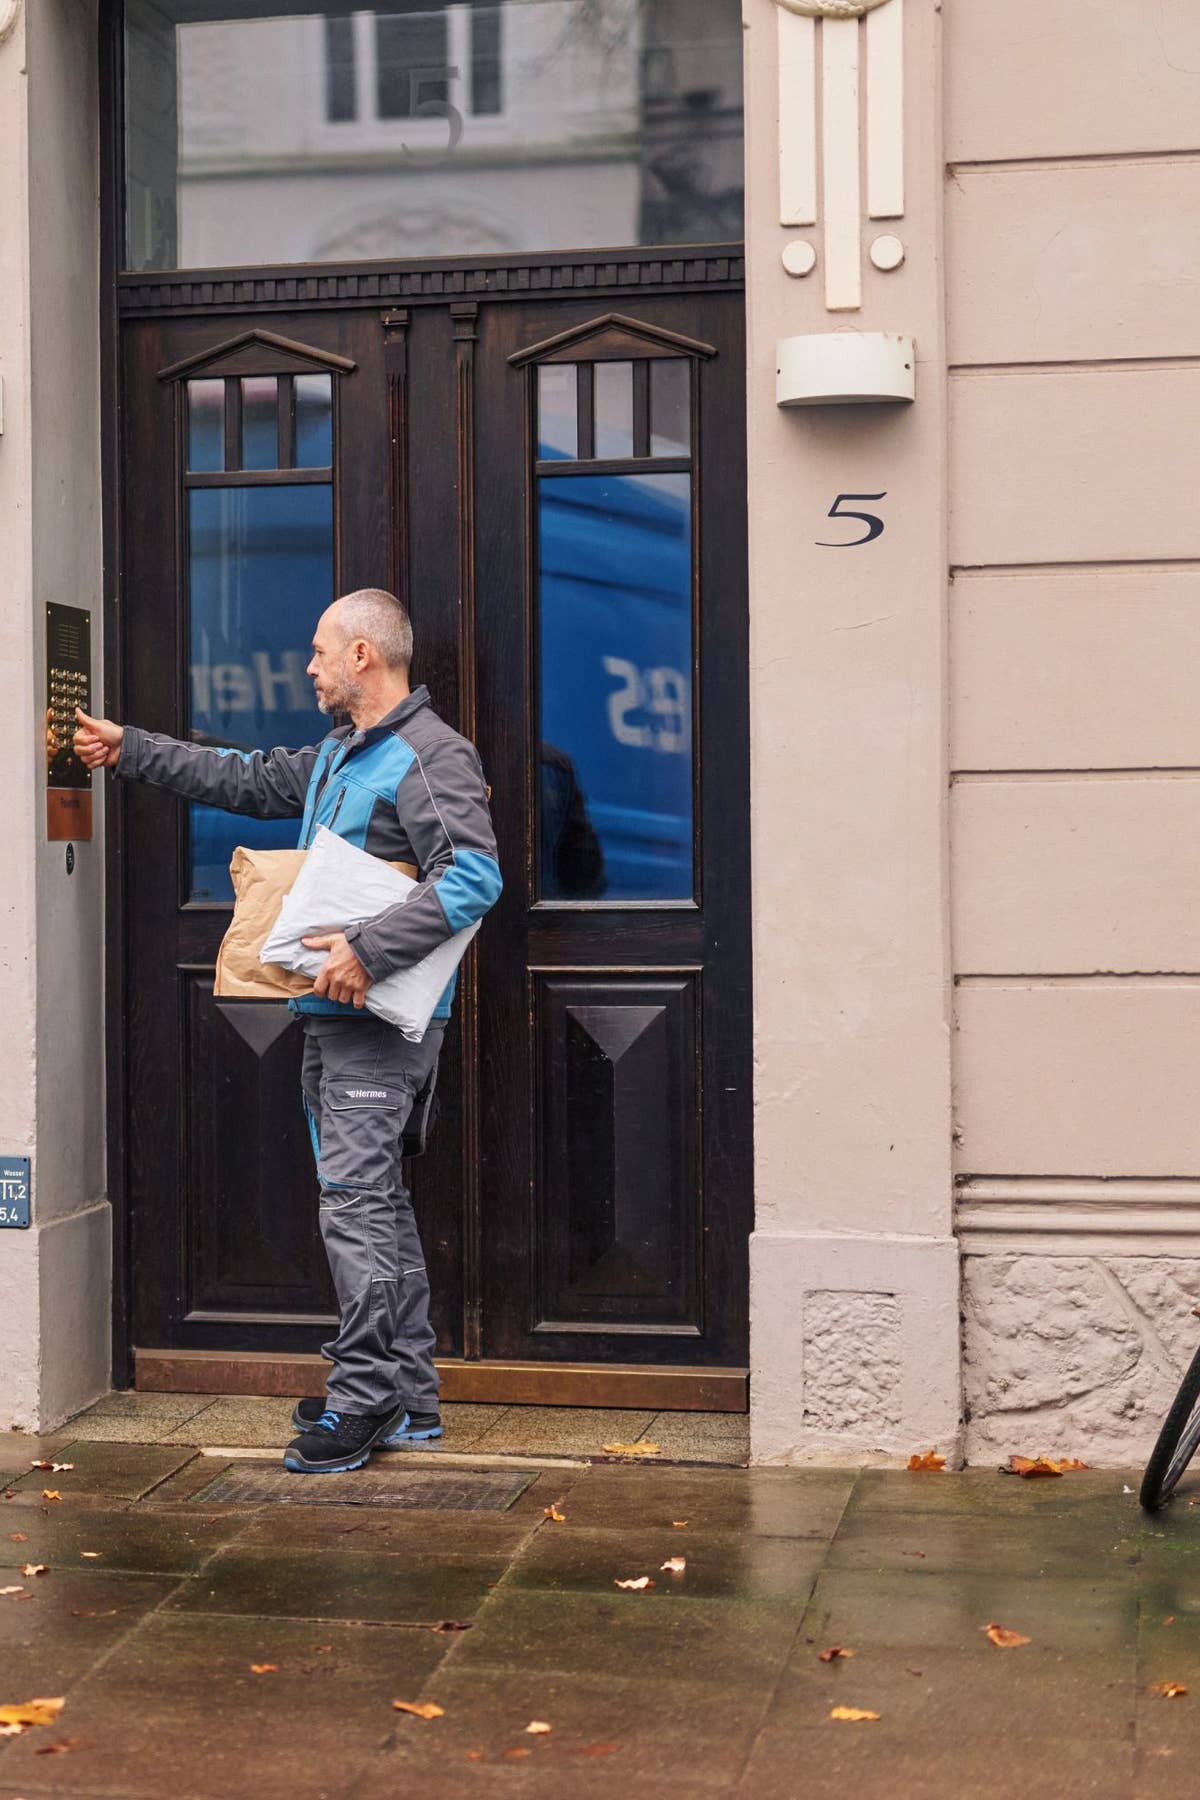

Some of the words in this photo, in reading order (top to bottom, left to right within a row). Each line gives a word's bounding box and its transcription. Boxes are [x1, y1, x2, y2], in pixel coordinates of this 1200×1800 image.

[400, 65, 464, 167] 5
[814, 491, 887, 547] 5
[355, 1089, 387, 1098] Hermes
[3, 1169, 25, 1177] Wasser
